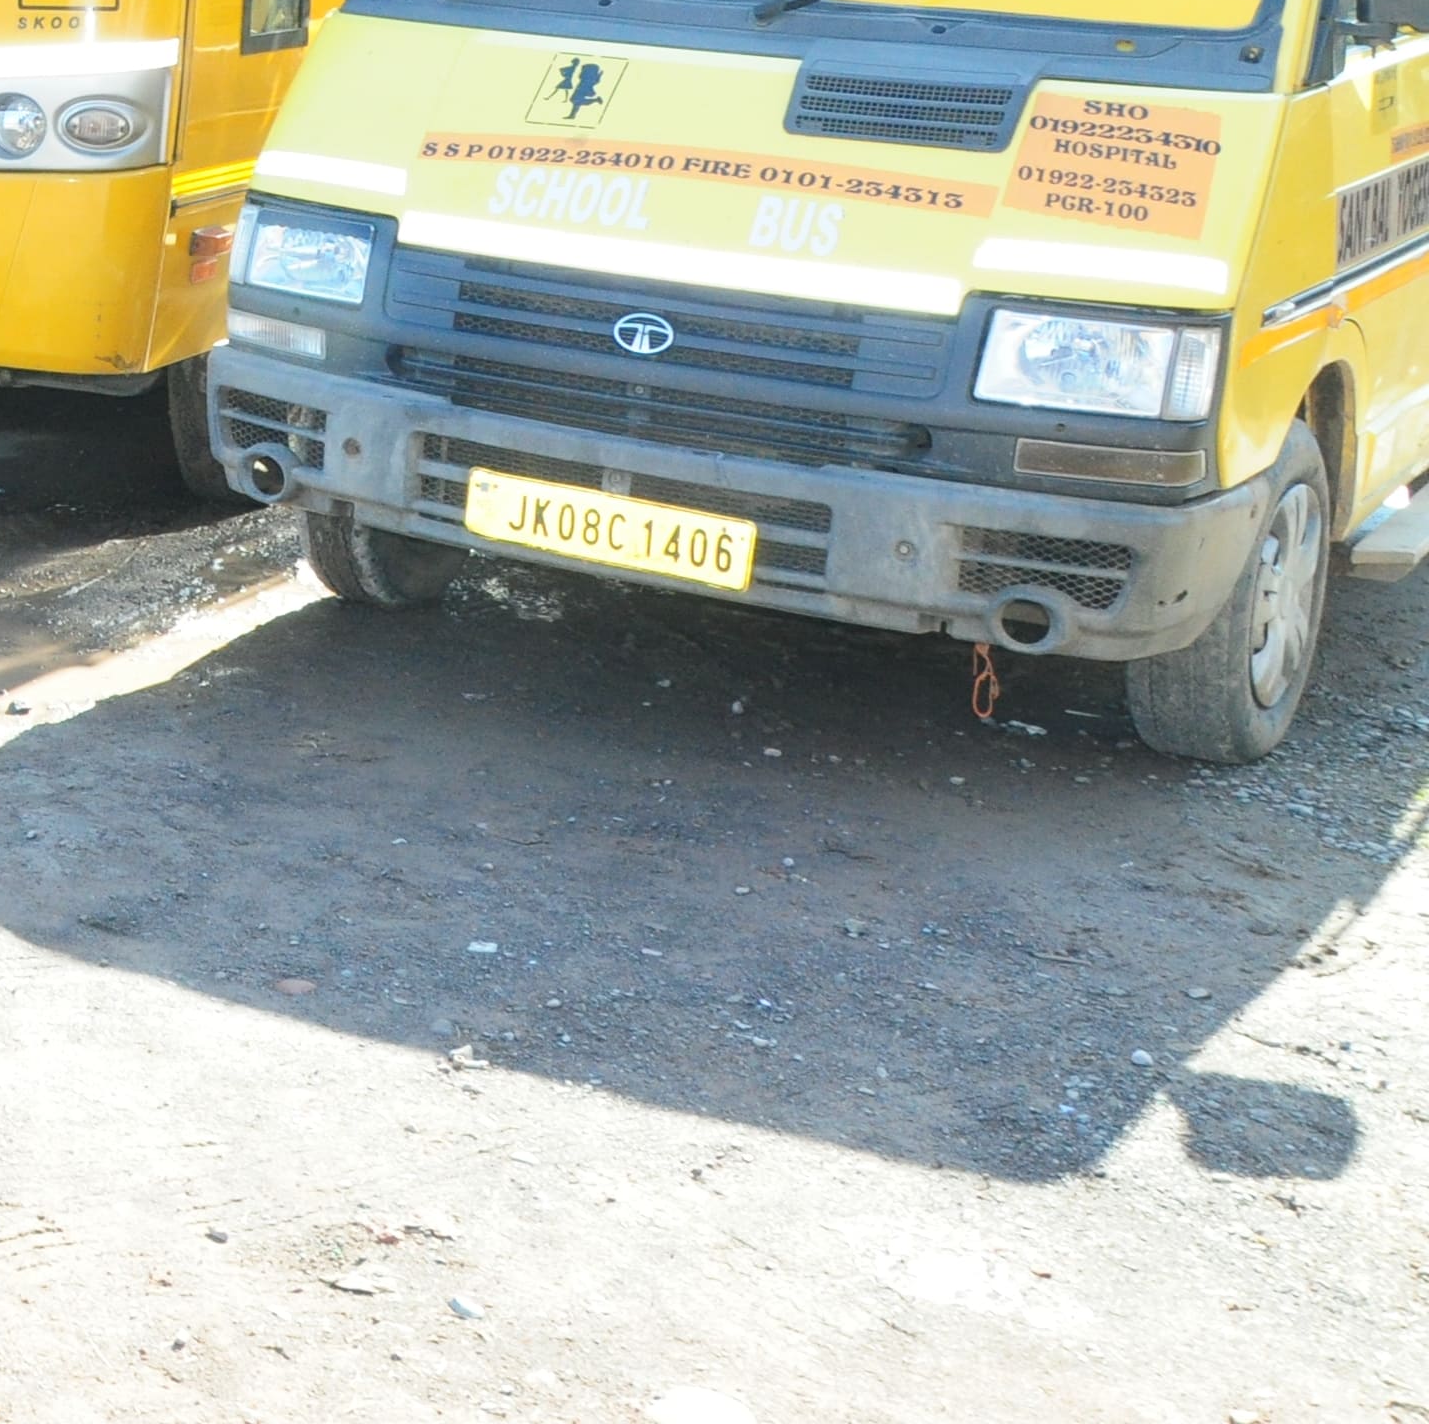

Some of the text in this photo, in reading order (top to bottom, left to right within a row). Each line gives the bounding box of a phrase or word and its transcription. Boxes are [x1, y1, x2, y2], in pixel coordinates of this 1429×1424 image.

[17, 16, 81, 30] SKOO
[1083, 99, 1149, 121] SHO
[681, 156, 753, 180] FIRE
[1054, 138, 1178, 170] HOSPITAL
[487, 166, 846, 258] SCHOOL BUS
[508, 495, 733, 572] JK08C 1406
